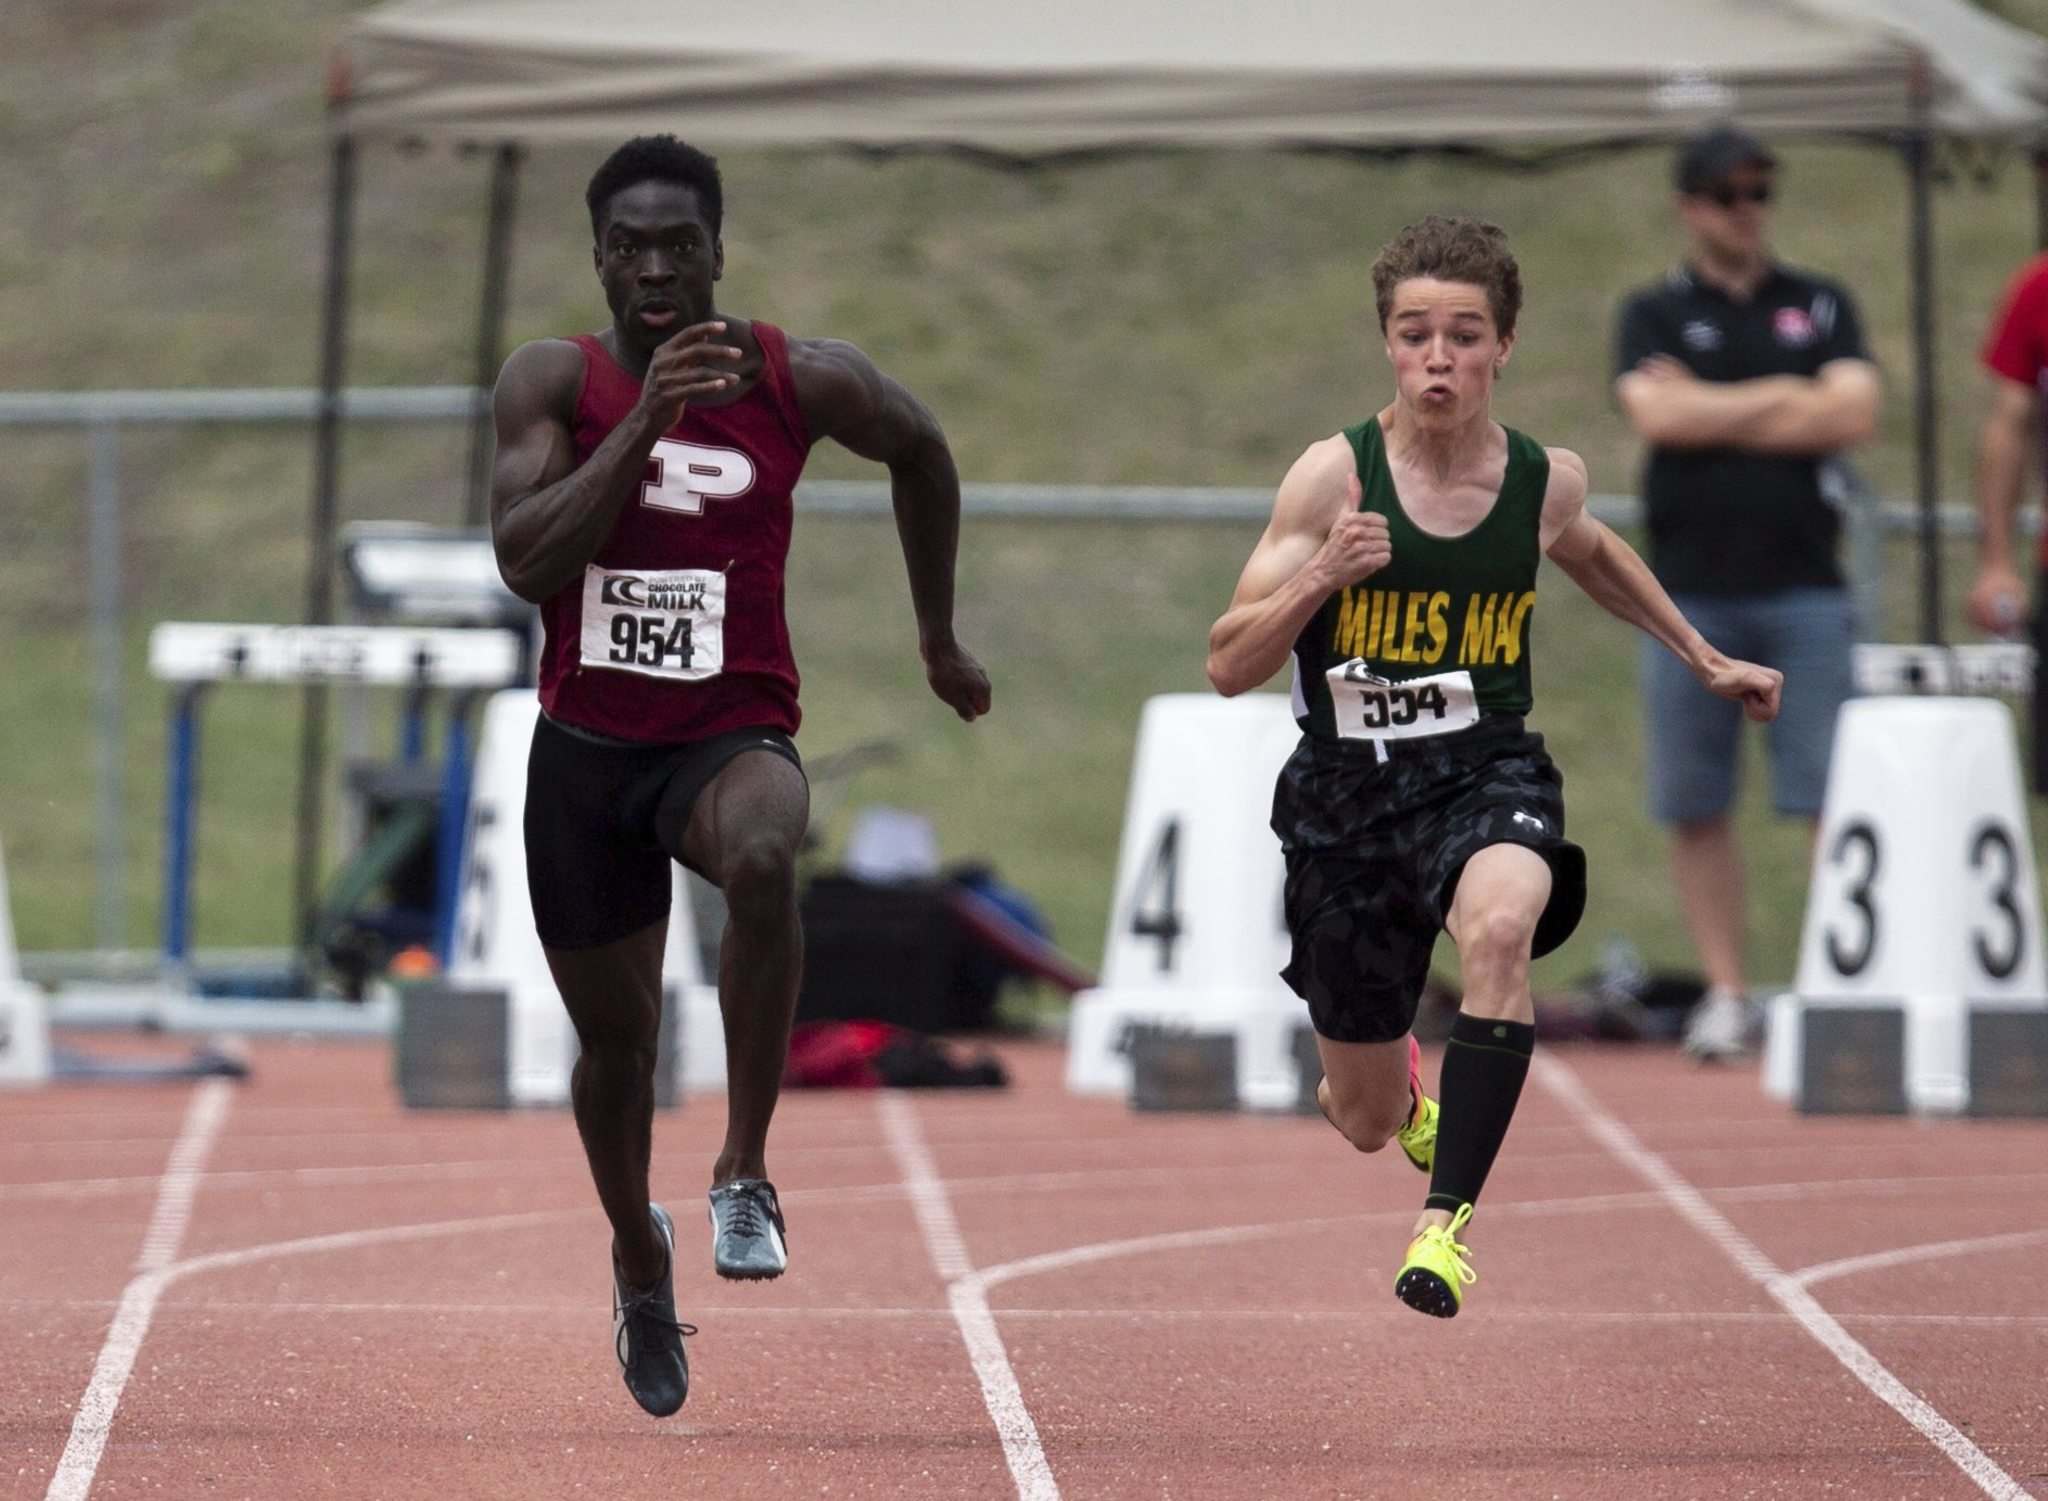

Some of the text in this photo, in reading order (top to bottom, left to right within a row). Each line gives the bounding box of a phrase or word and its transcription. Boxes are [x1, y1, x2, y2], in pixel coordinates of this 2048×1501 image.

[640, 437, 756, 515] P
[648, 583, 706, 592] CHOCOLATE
[648, 593, 706, 610] MILK
[1333, 584, 1450, 665] MILES
[609, 613, 695, 669] 954
[1129, 814, 1182, 972] 4
[1826, 818, 1880, 978] 3
[1970, 820, 2023, 979] 3
